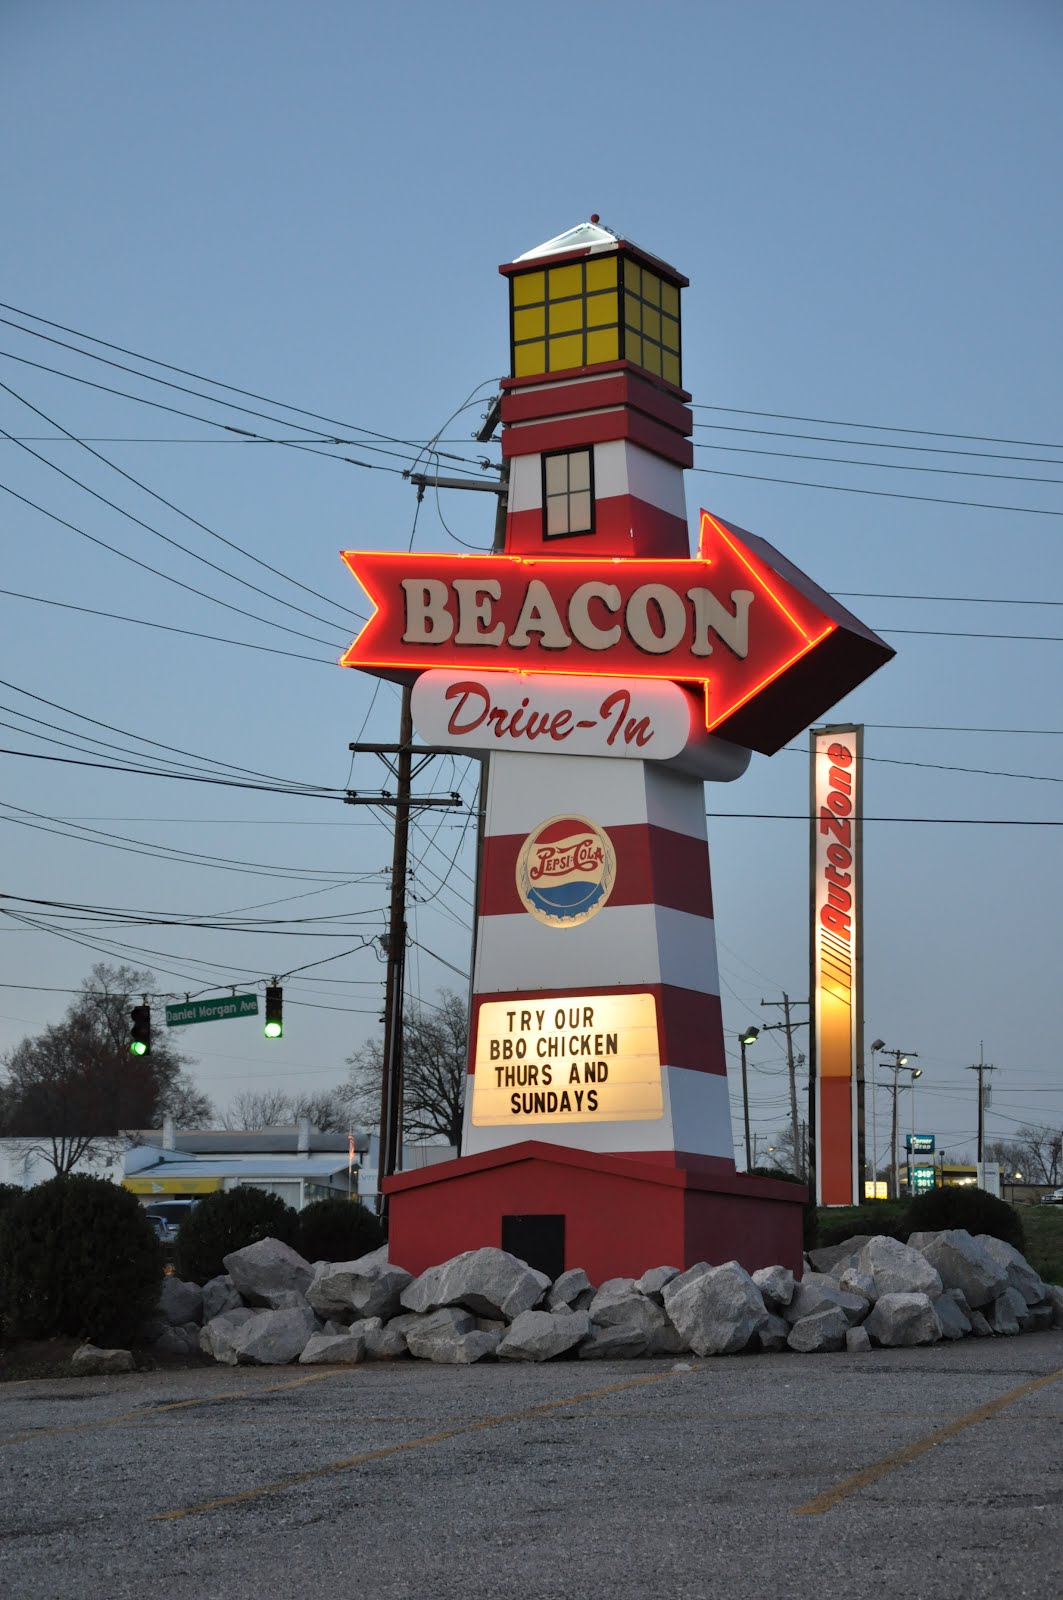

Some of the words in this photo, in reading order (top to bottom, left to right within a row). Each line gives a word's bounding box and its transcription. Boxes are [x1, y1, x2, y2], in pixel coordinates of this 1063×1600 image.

[400, 578, 755, 659] BEACON
[445, 681, 655, 747] Drive-In
[820, 742, 852, 941] AutoZone
[166, 1008, 196, 1022] Daniel
[199, 1003, 237, 1017] Morgan
[240, 1000, 257, 1011] Ave
[507, 1010, 545, 1032] TRY
[554, 1006, 594, 1030] OUR
[536, 1033, 618, 1058] CHICKEN
[495, 1064, 552, 1087] THURS
[568, 1061, 609, 1084] AND
[511, 1089, 598, 1114] SUNDAYS
